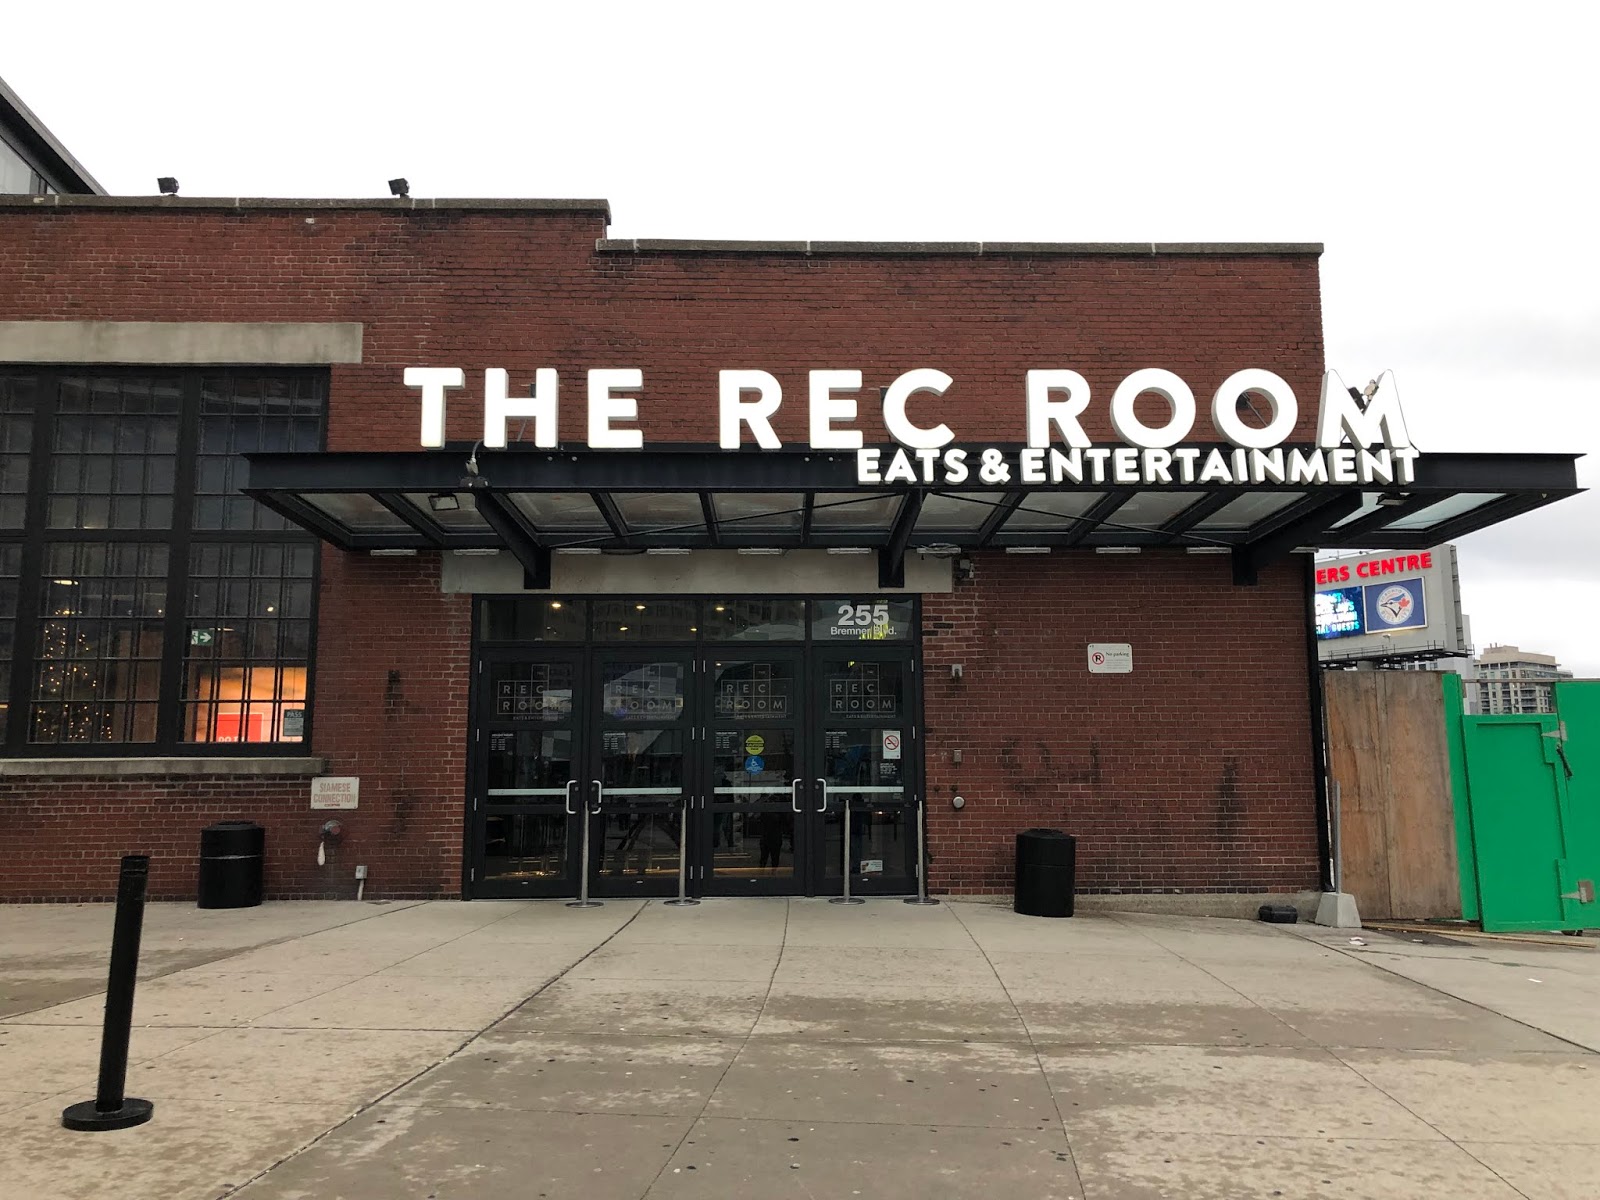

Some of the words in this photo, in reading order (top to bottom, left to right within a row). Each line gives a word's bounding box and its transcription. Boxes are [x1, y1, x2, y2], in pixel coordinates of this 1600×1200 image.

[403, 367, 644, 450] THE
[718, 367, 956, 450] REC
[1026, 367, 1413, 450] ROOM
[857, 447, 969, 486] EATS
[980, 447, 1011, 485] &
[1020, 447, 1421, 486] ENTERTAINMENT
[1356, 551, 1433, 579] CENTRE
[838, 604, 890, 626] 255
[830, 626, 870, 635] Bremner
[503, 684, 545, 695] REC
[615, 684, 656, 694] REC
[726, 684, 766, 694] REC
[835, 683, 875, 693] REC
[726, 700, 783, 709] ROOM
[835, 699, 892, 709] ROOM
[319, 782, 351, 793] SIAMESE
[313, 793, 356, 803] CONNECTION
